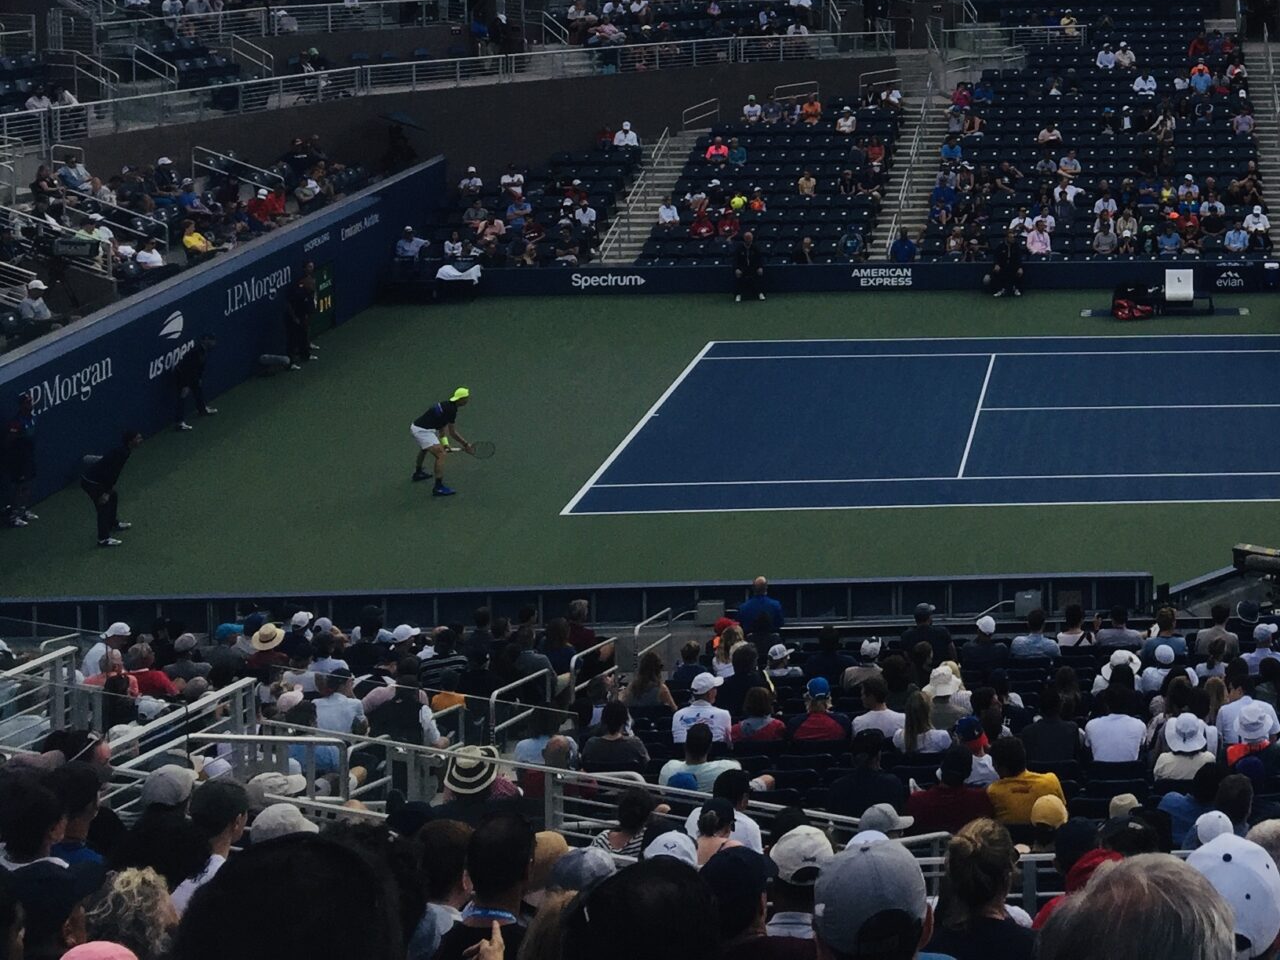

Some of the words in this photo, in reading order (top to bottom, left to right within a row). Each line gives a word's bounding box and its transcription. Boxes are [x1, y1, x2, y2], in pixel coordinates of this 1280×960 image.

[851, 267, 912, 277] AMERICAN
[571, 272, 640, 290] Spectrum
[859, 276, 913, 286] EXPRESS
[1215, 276, 1245, 288] evian
[149, 357, 164, 380] us
